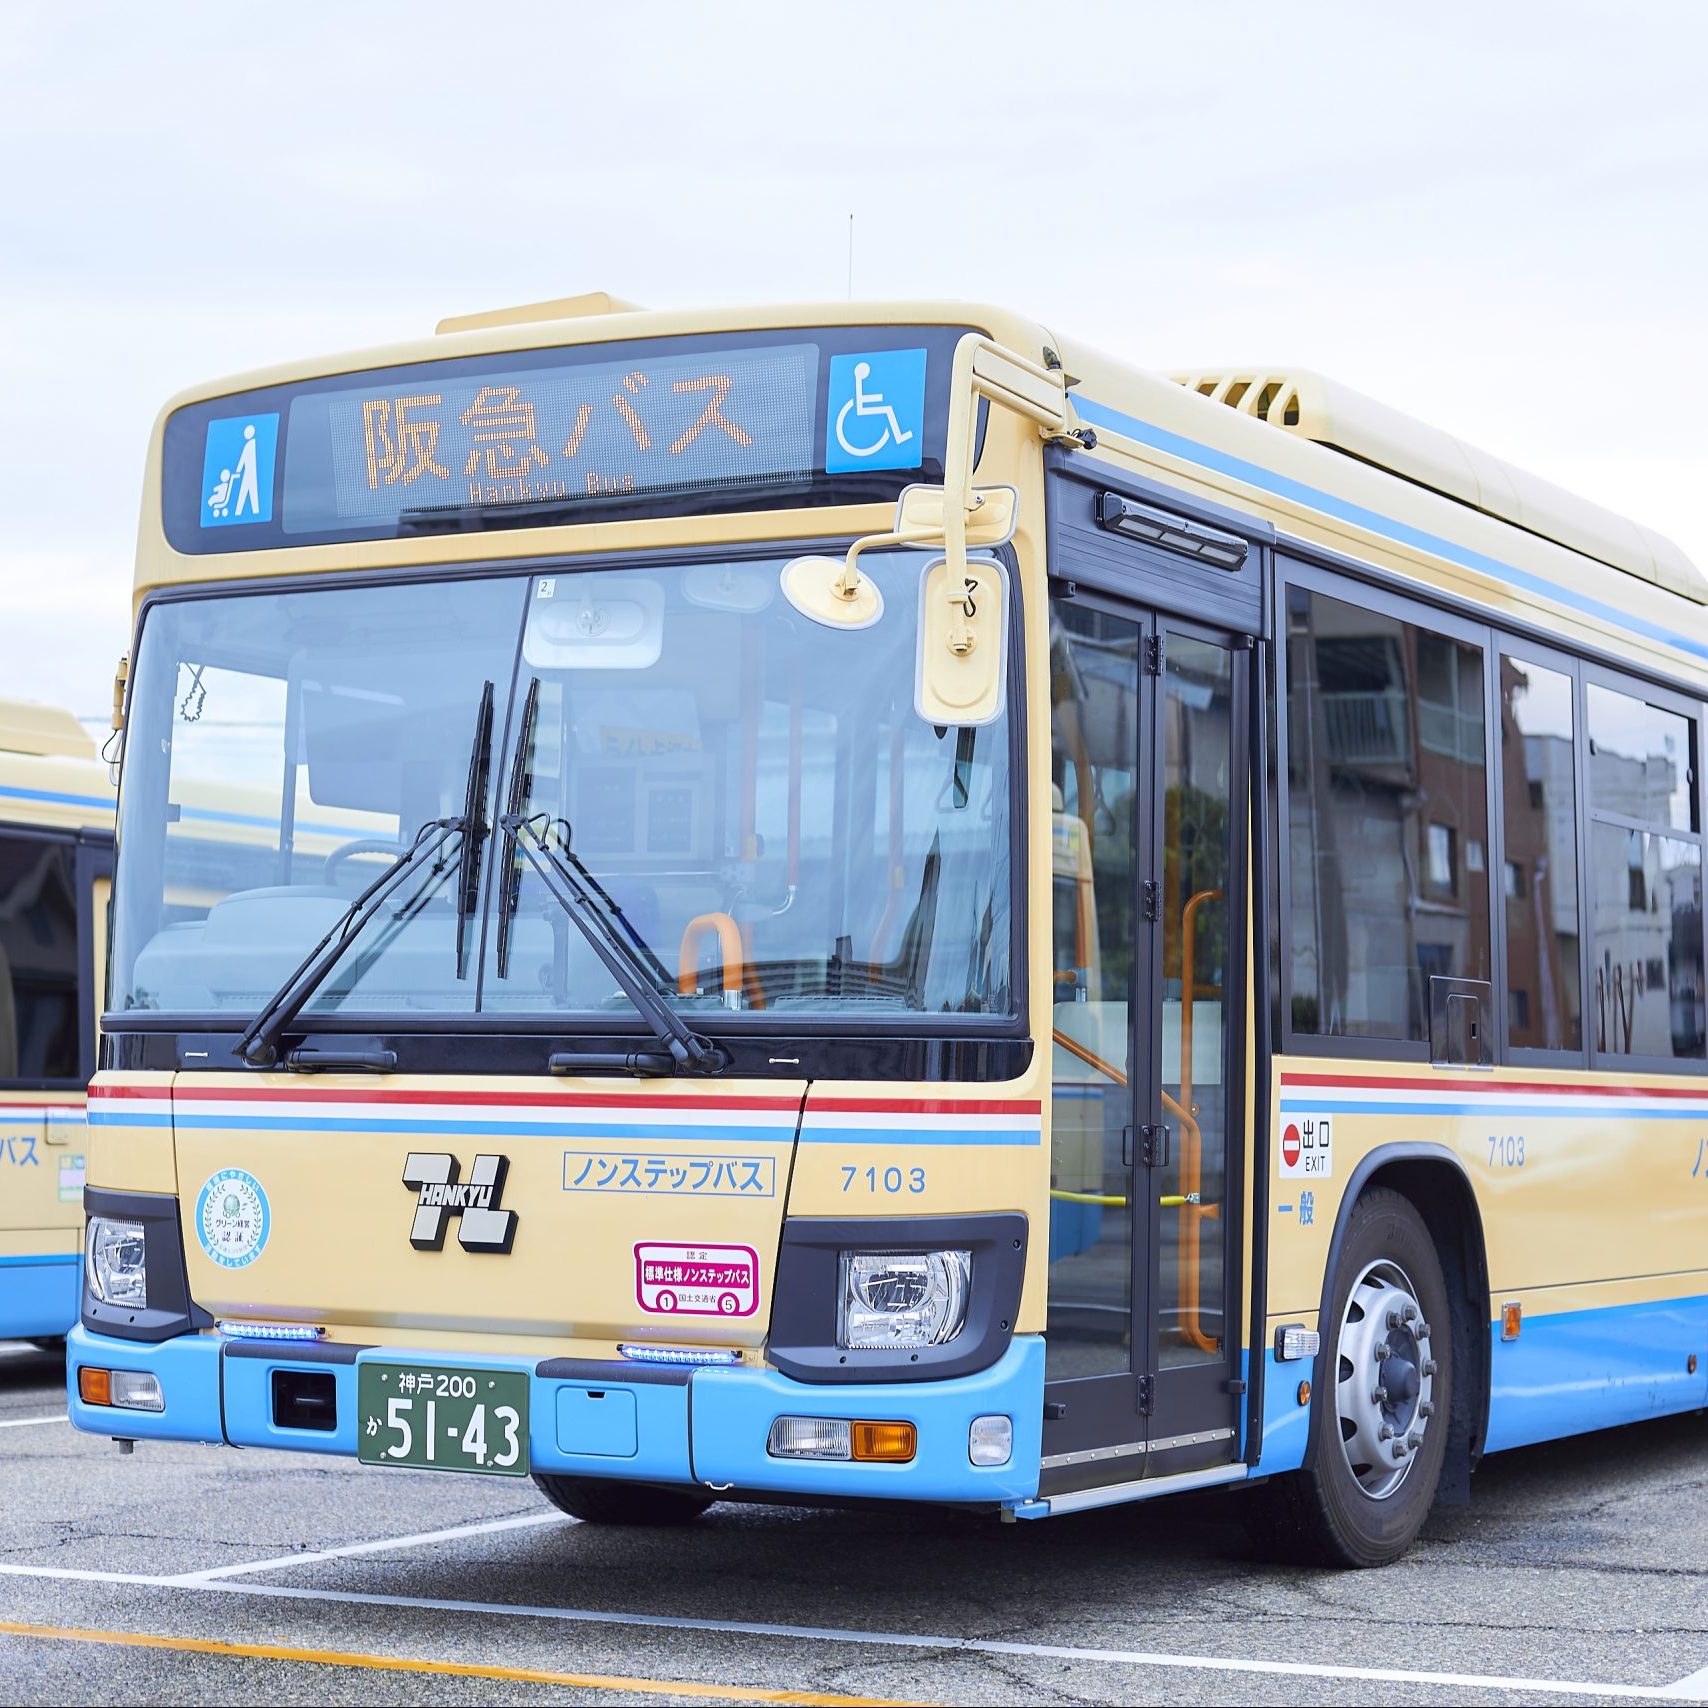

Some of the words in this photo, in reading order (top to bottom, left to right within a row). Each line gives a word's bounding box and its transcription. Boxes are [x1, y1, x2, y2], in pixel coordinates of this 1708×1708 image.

[363, 371, 752, 489] 阪急バス
[469, 478, 566, 504] Hankyu
[587, 472, 634, 495] Bus
[1303, 1120, 1330, 1148] 出口
[1305, 1156, 1326, 1172] EXIT
[1488, 1136, 1525, 1166] 7103
[573, 1158, 764, 1192] ノンステップバス
[841, 1166, 926, 1193] 7103
[418, 1184, 494, 1208] HANKYU
[1278, 1190, 1315, 1225] 一般
[686, 1250, 708, 1261] 認定
[645, 1265, 750, 1284] 標準仕様ノンステップバス
[725, 1299, 733, 1311] 5
[366, 1415, 383, 1437] か
[387, 1397, 520, 1467] 51-43
